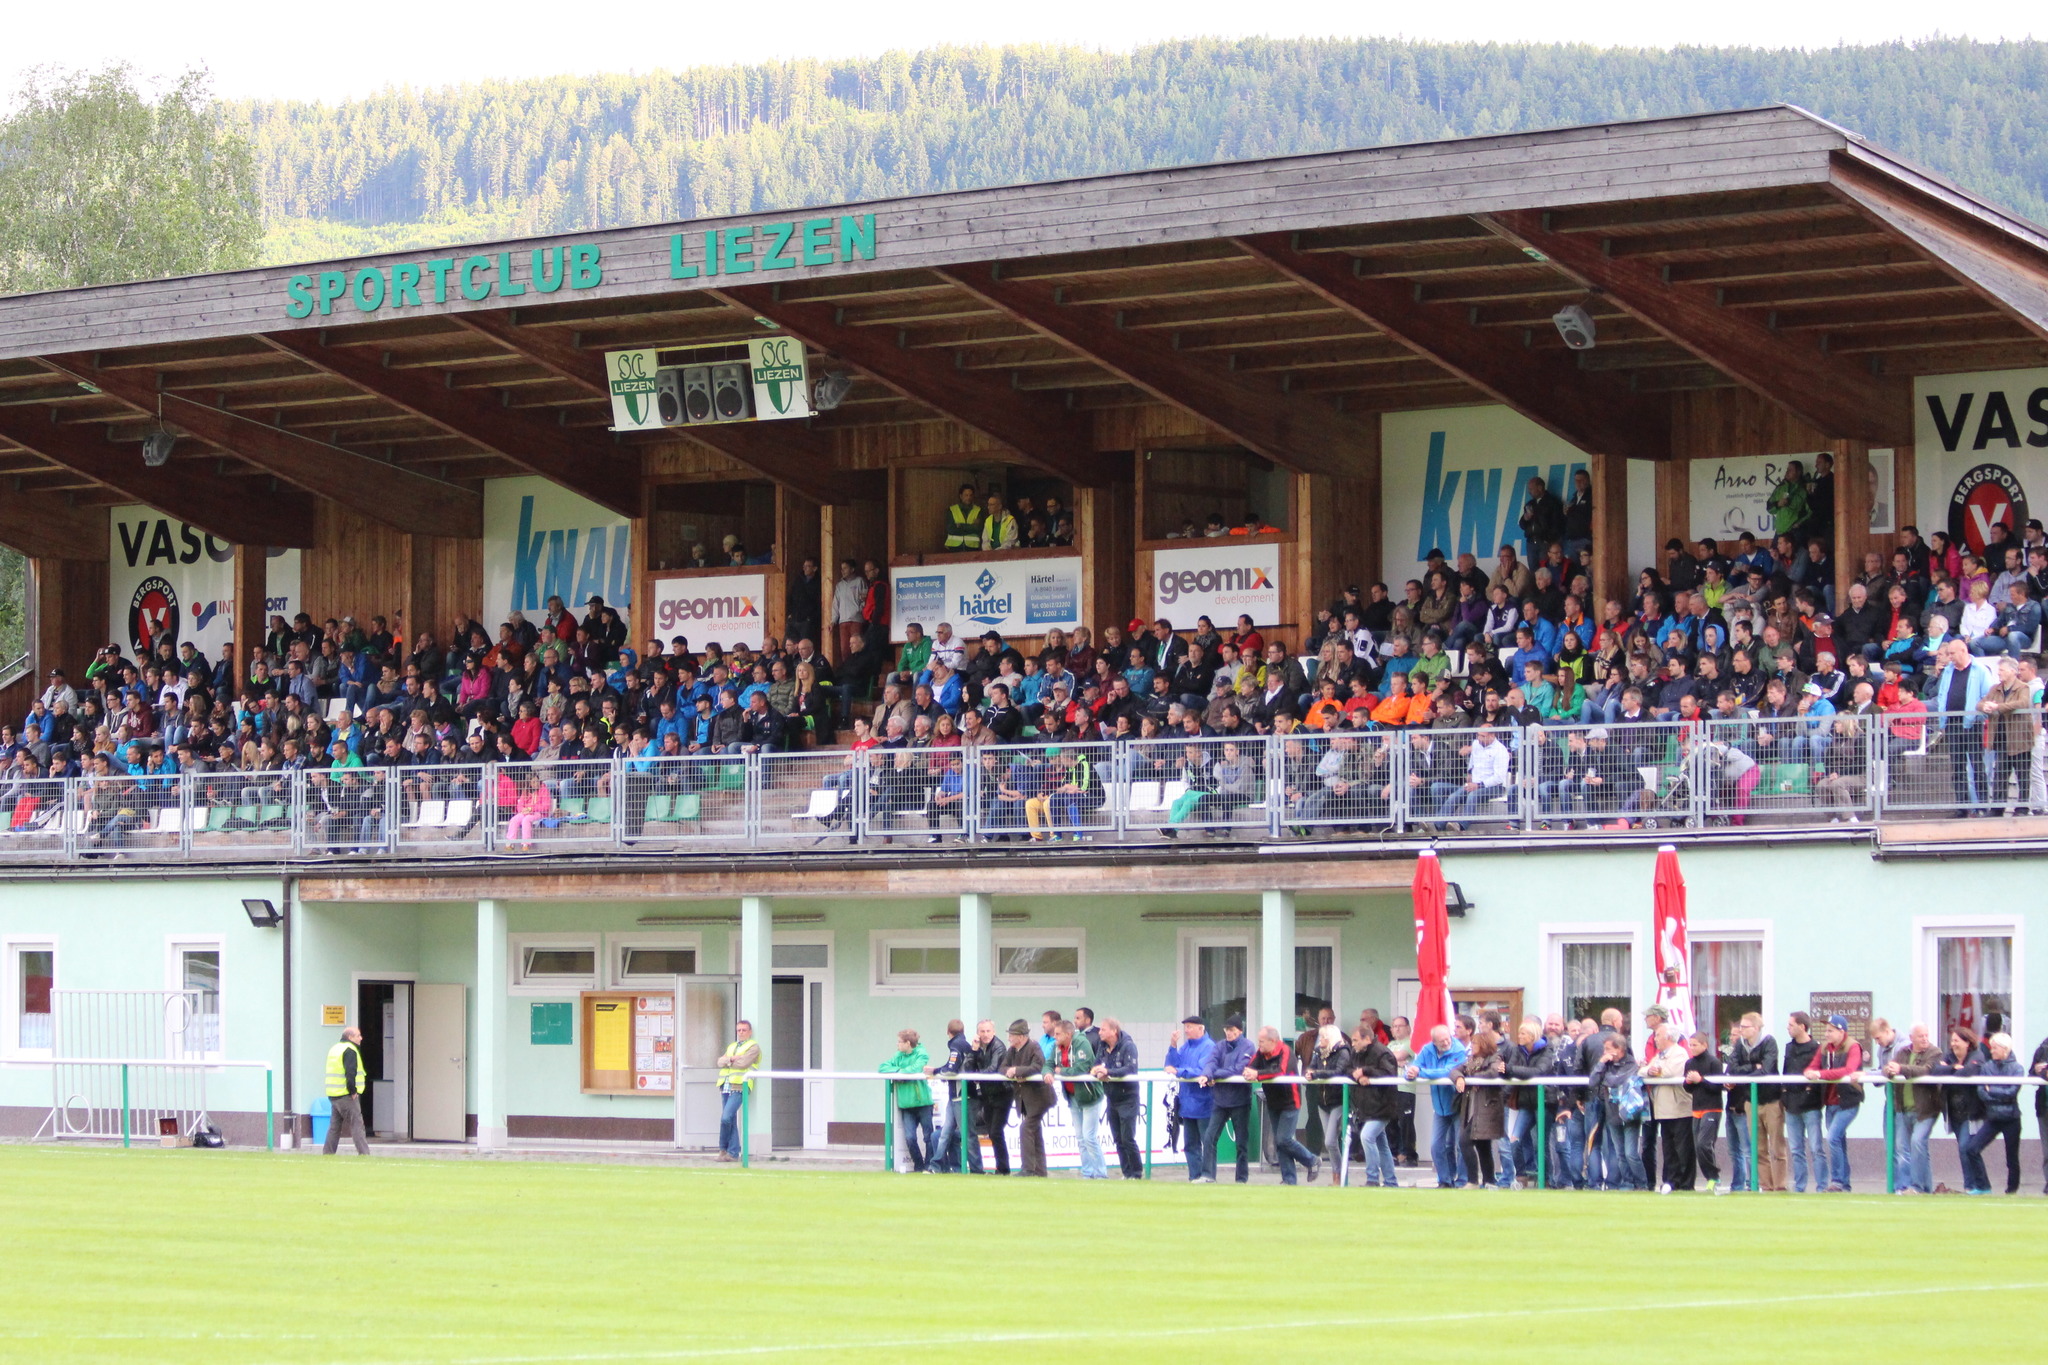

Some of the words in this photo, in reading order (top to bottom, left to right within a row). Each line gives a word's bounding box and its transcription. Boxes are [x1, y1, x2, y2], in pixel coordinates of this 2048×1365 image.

[286, 243, 602, 319] SPORTCLUB
[671, 214, 876, 279] LIEZEN
[757, 368, 800, 381] LIEZEN
[614, 380, 655, 394] LIEZEN
[1714, 465, 1757, 490] Arno
[1954, 467, 2023, 504] BERGSPORT
[1031, 574, 1055, 584] Härtel
[1159, 567, 1274, 604] geomix
[132, 579, 177, 608] BERGSPORT
[959, 593, 1012, 615] härtel
[1215, 592, 1275, 605] development
[659, 595, 760, 630] geomix
[901, 604, 920, 613] geben
[920, 603, 929, 611] bei
[707, 620, 760, 632] development
